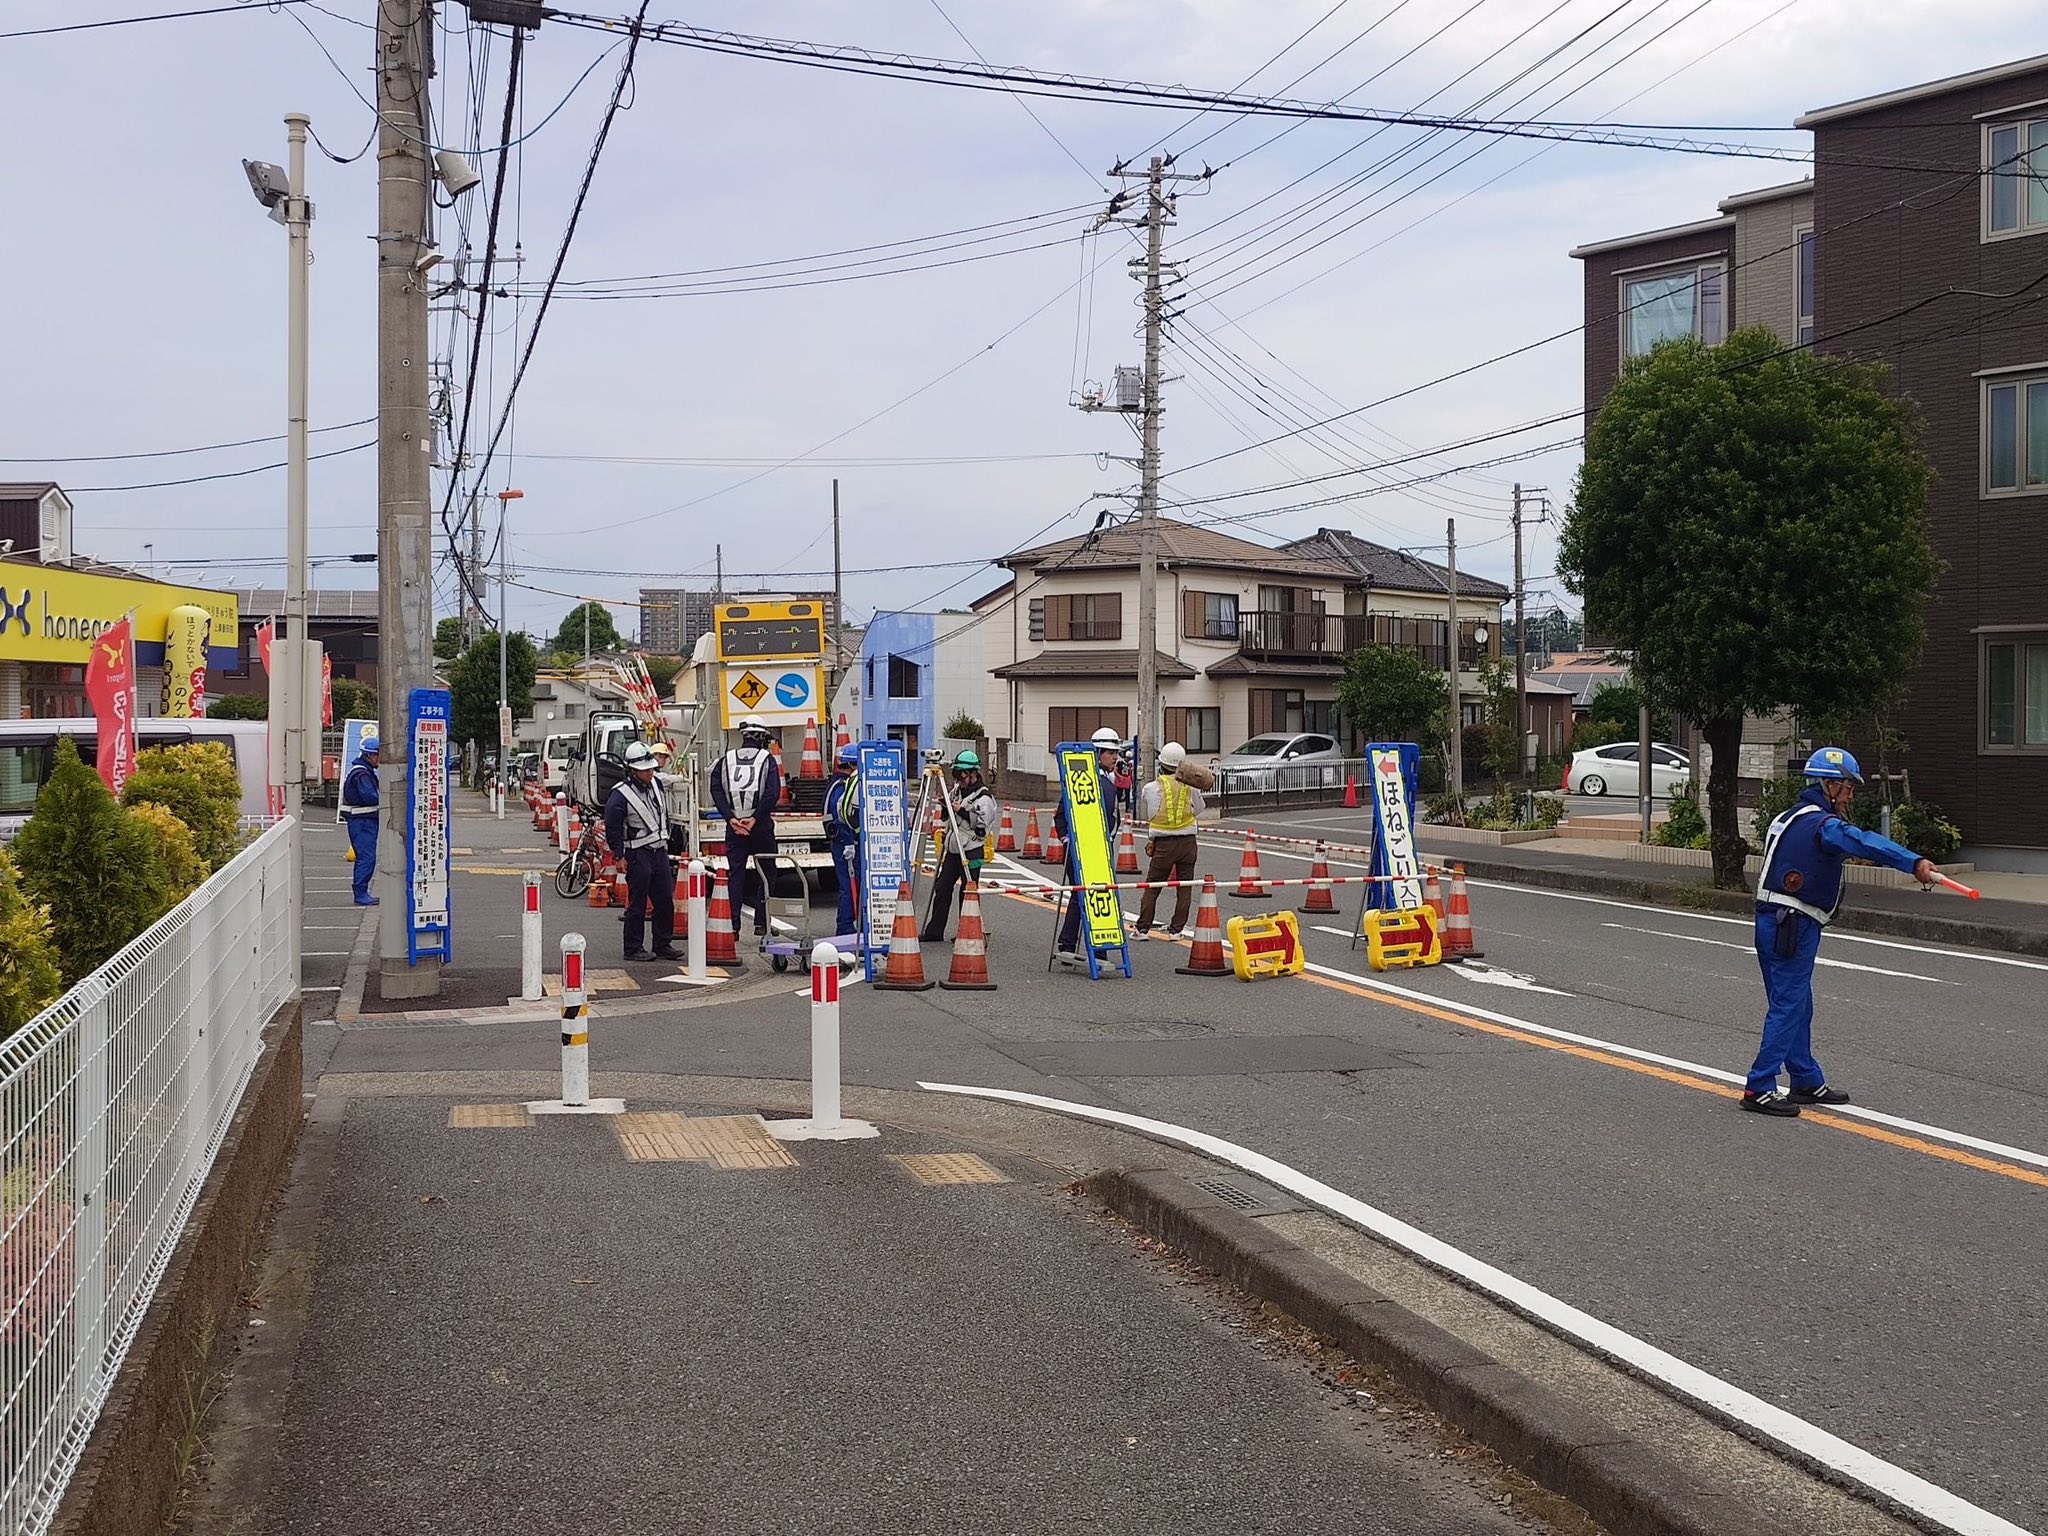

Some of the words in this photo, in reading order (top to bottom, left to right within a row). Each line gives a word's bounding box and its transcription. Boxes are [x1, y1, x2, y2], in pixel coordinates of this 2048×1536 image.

[420, 706, 444, 716] 工事予告
[733, 766, 756, 790] り
[868, 768, 897, 777] おかけします
[874, 799, 894, 812] 新設を
[868, 814, 900, 827] 行っています
